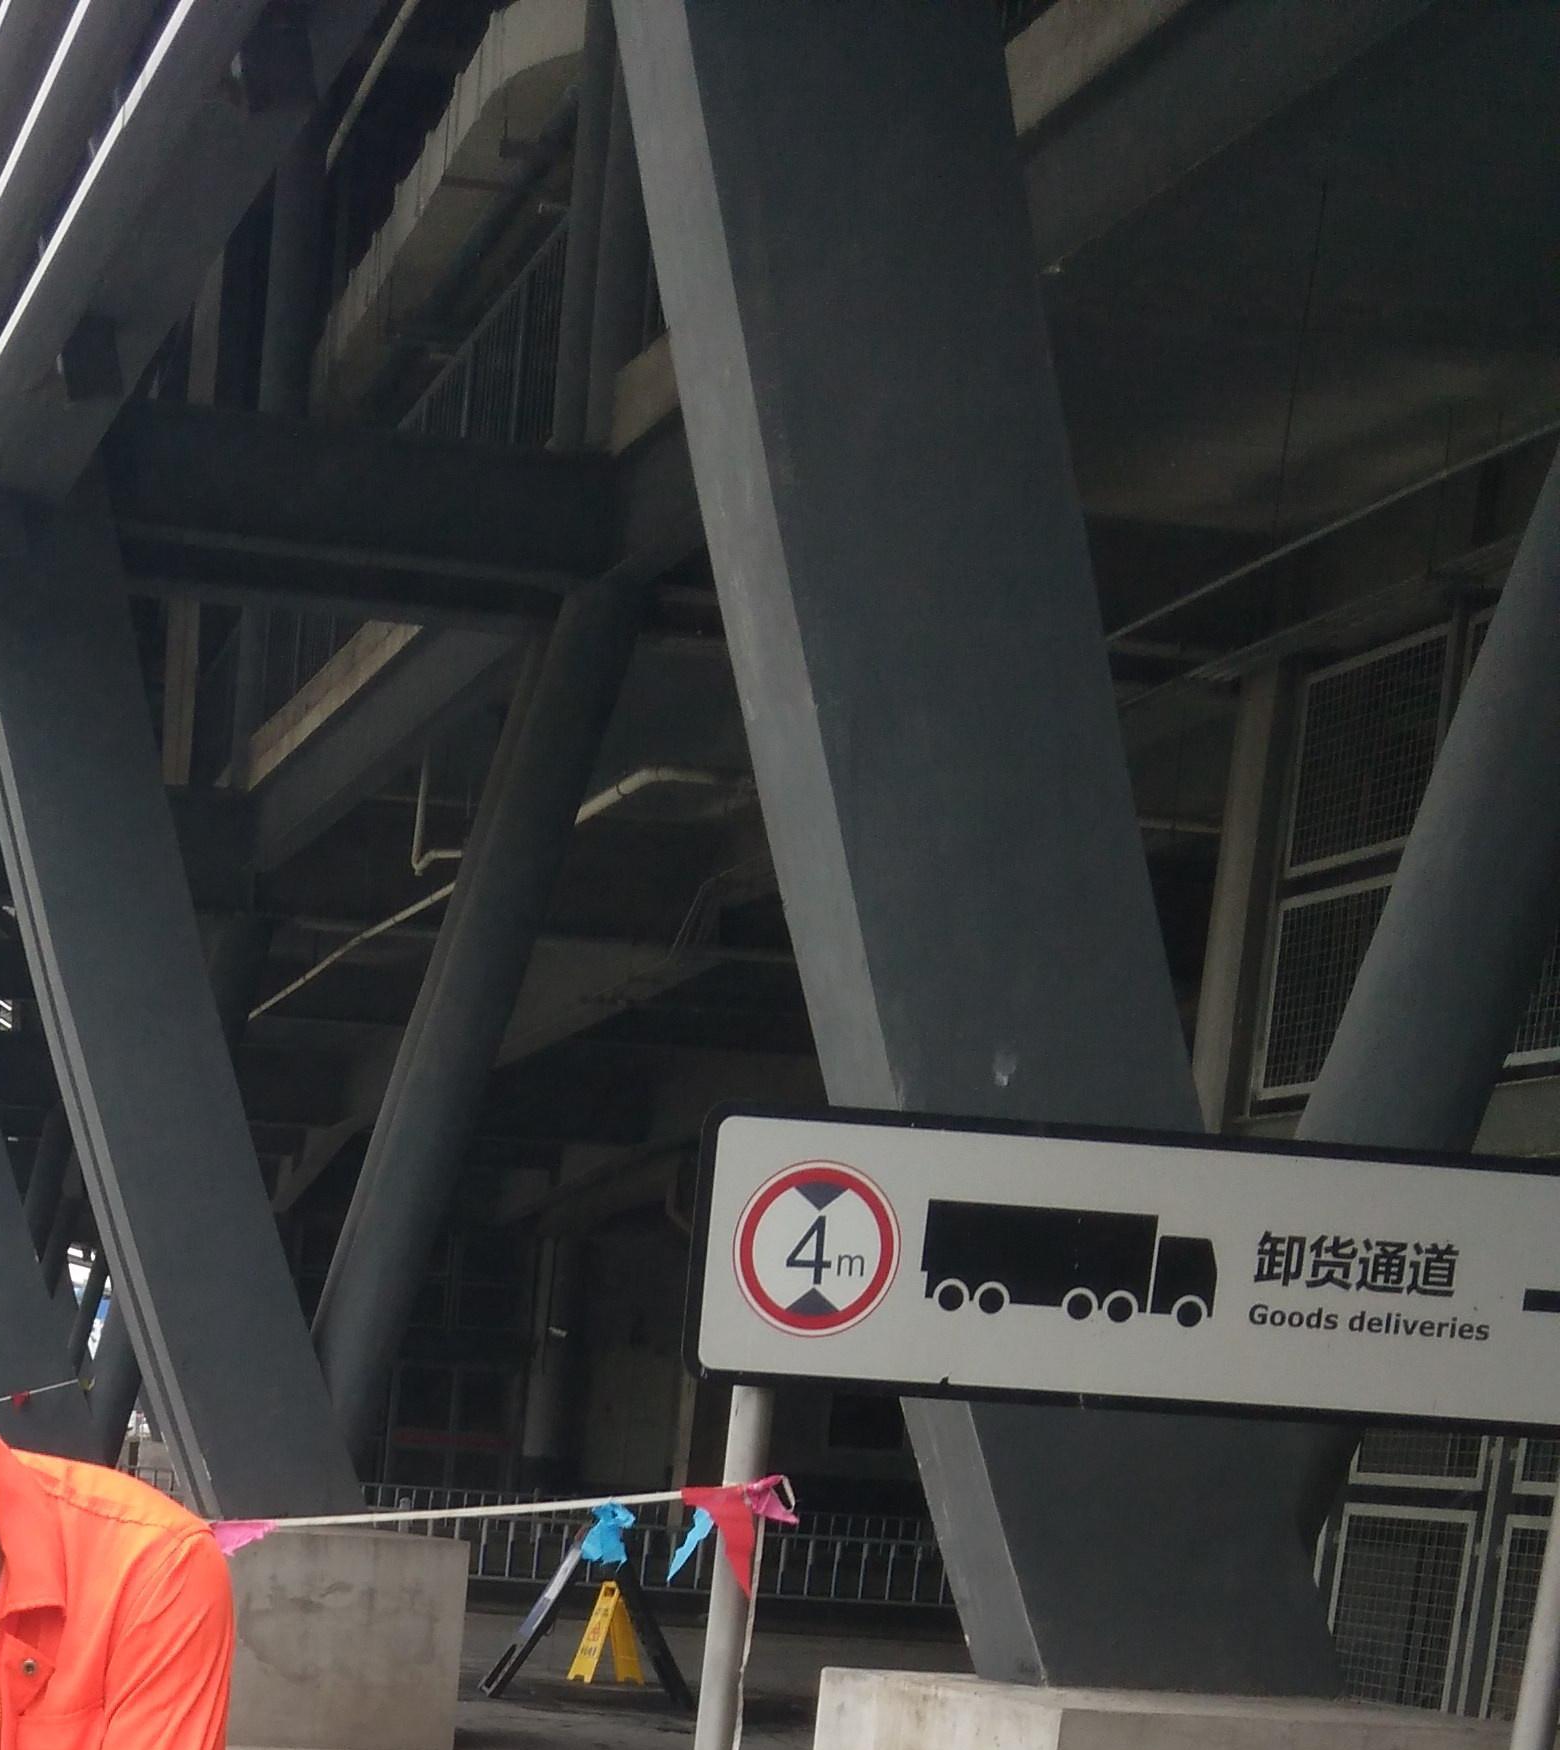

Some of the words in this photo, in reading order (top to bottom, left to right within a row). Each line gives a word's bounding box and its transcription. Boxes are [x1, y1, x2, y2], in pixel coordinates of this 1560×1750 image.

[1253, 1230, 1460, 1297] 卸货通道
[1248, 1303, 1339, 1330] Goods
[1348, 1310, 1490, 1341] deliveries
